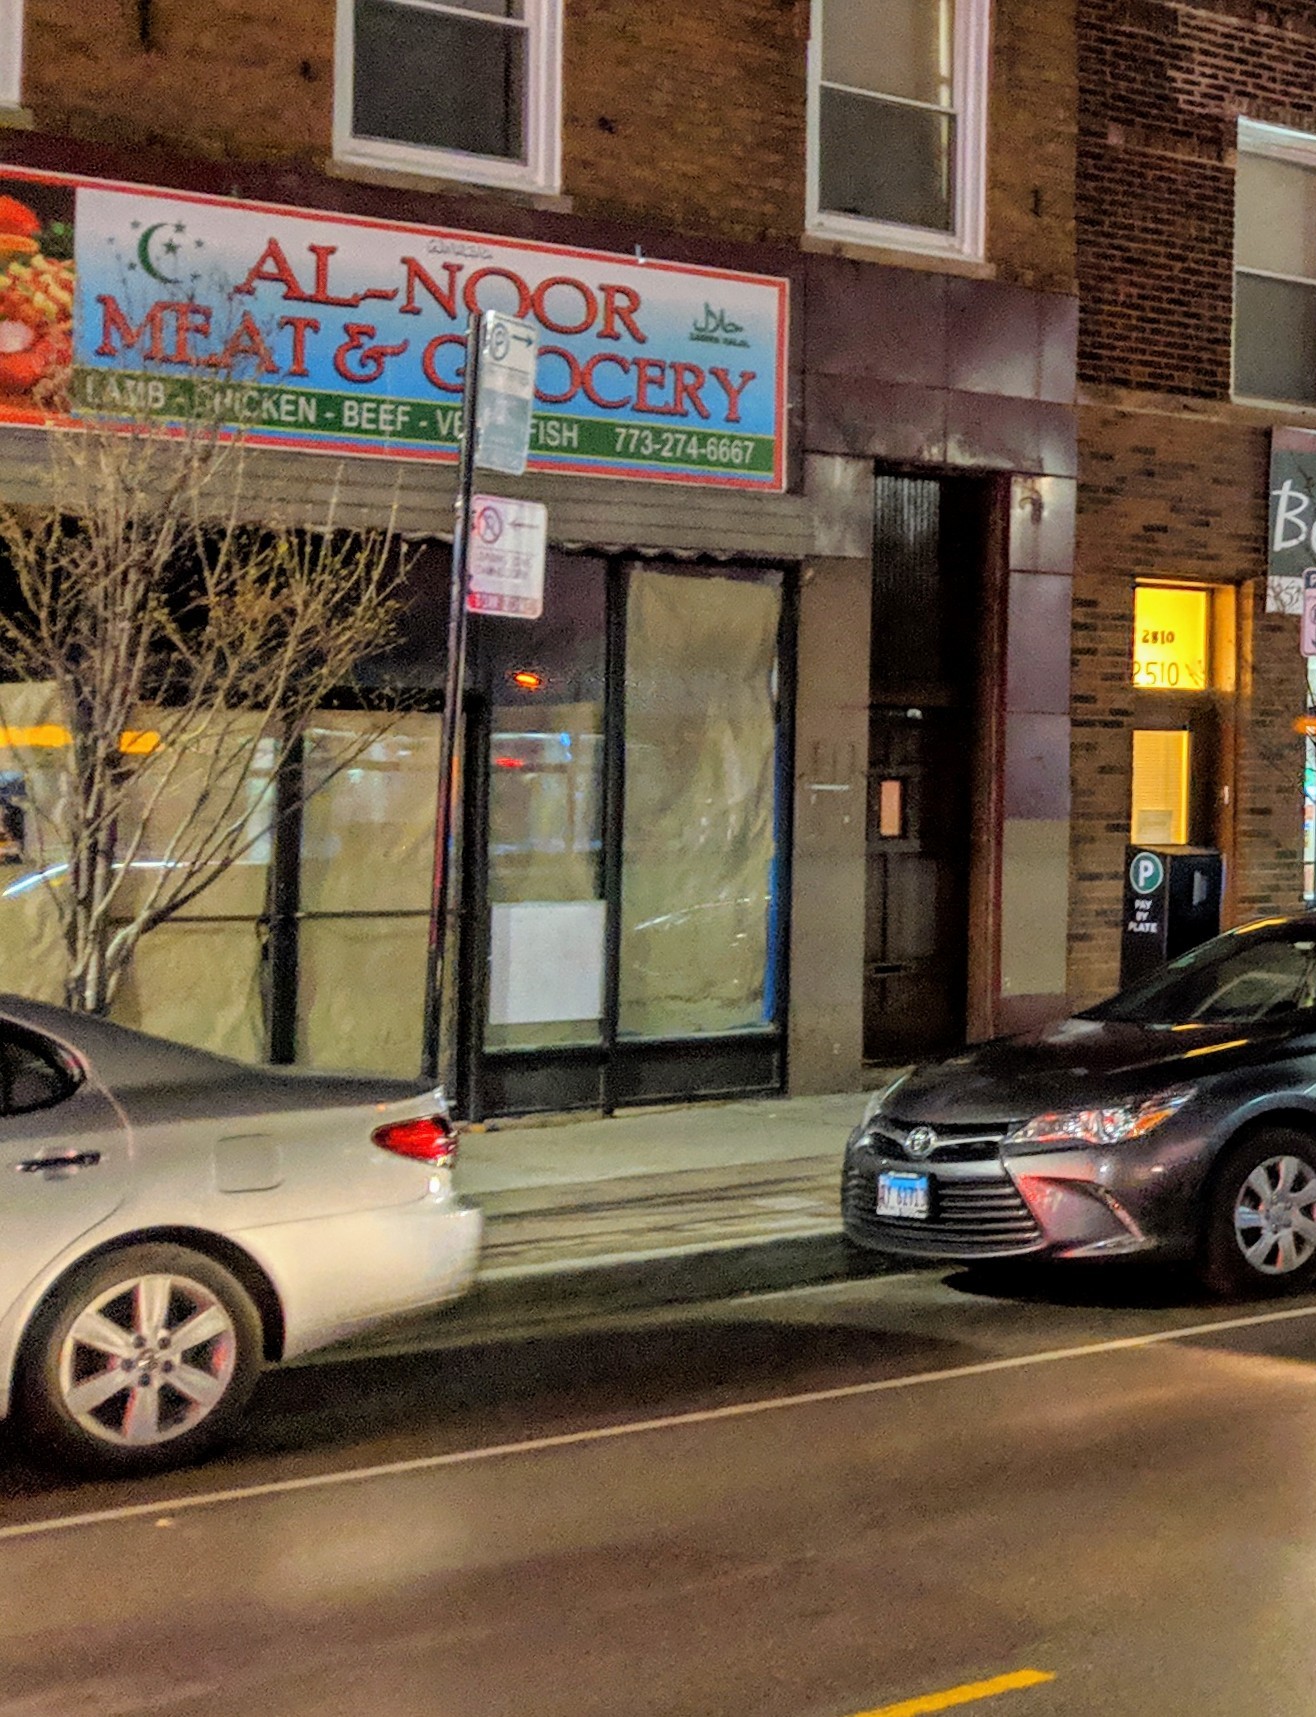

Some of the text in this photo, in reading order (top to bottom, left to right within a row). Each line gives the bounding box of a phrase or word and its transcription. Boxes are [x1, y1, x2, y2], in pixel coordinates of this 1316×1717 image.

[232, 237, 648, 343] AL-NOOR
[95, 294, 757, 423] MEAT & GOCERY
[86, 375, 166, 409] LAMB
[342, 400, 411, 432] BEEF
[613, 427, 755, 464] 773-274-6667
[1128, 921, 1158, 933] PLATE
